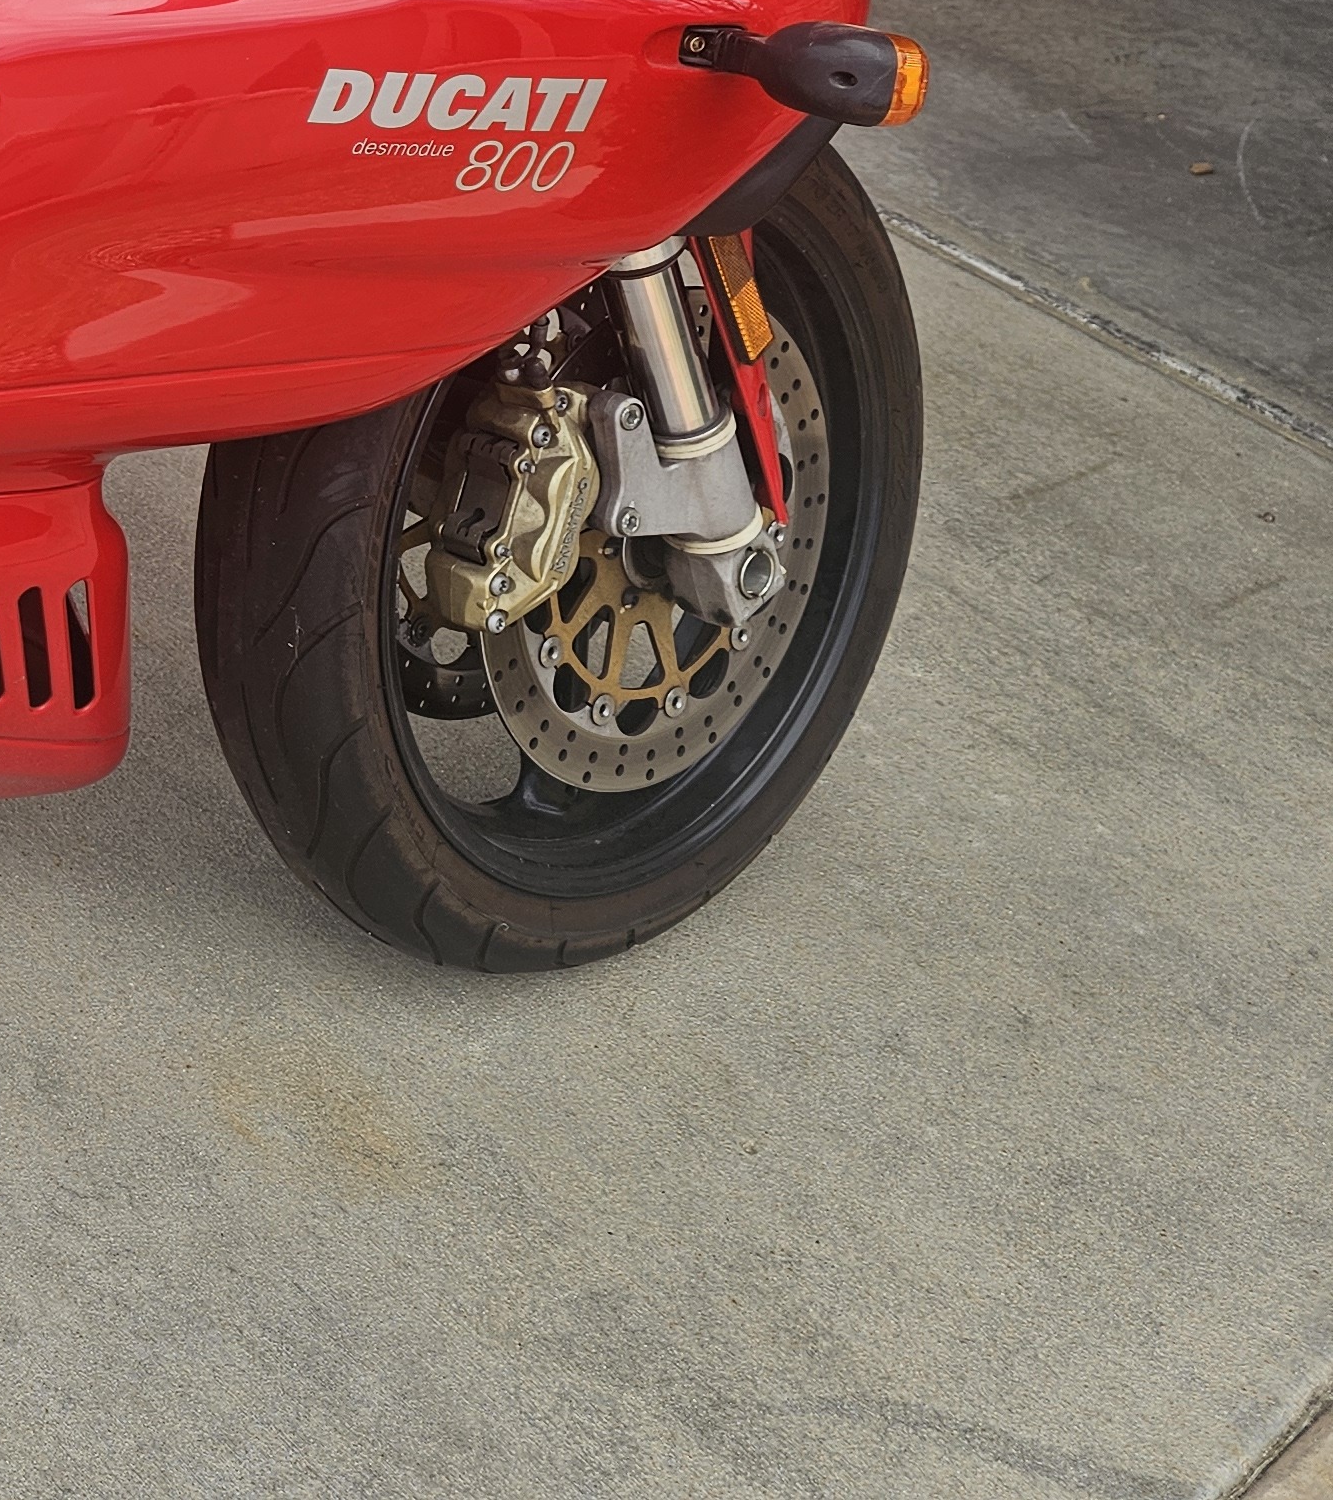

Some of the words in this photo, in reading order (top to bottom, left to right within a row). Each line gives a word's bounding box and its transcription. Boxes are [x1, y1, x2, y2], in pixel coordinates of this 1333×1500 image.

[307, 68, 607, 132] DUCATI
[351, 137, 454, 158] desmodue
[454, 140, 575, 192] 800
